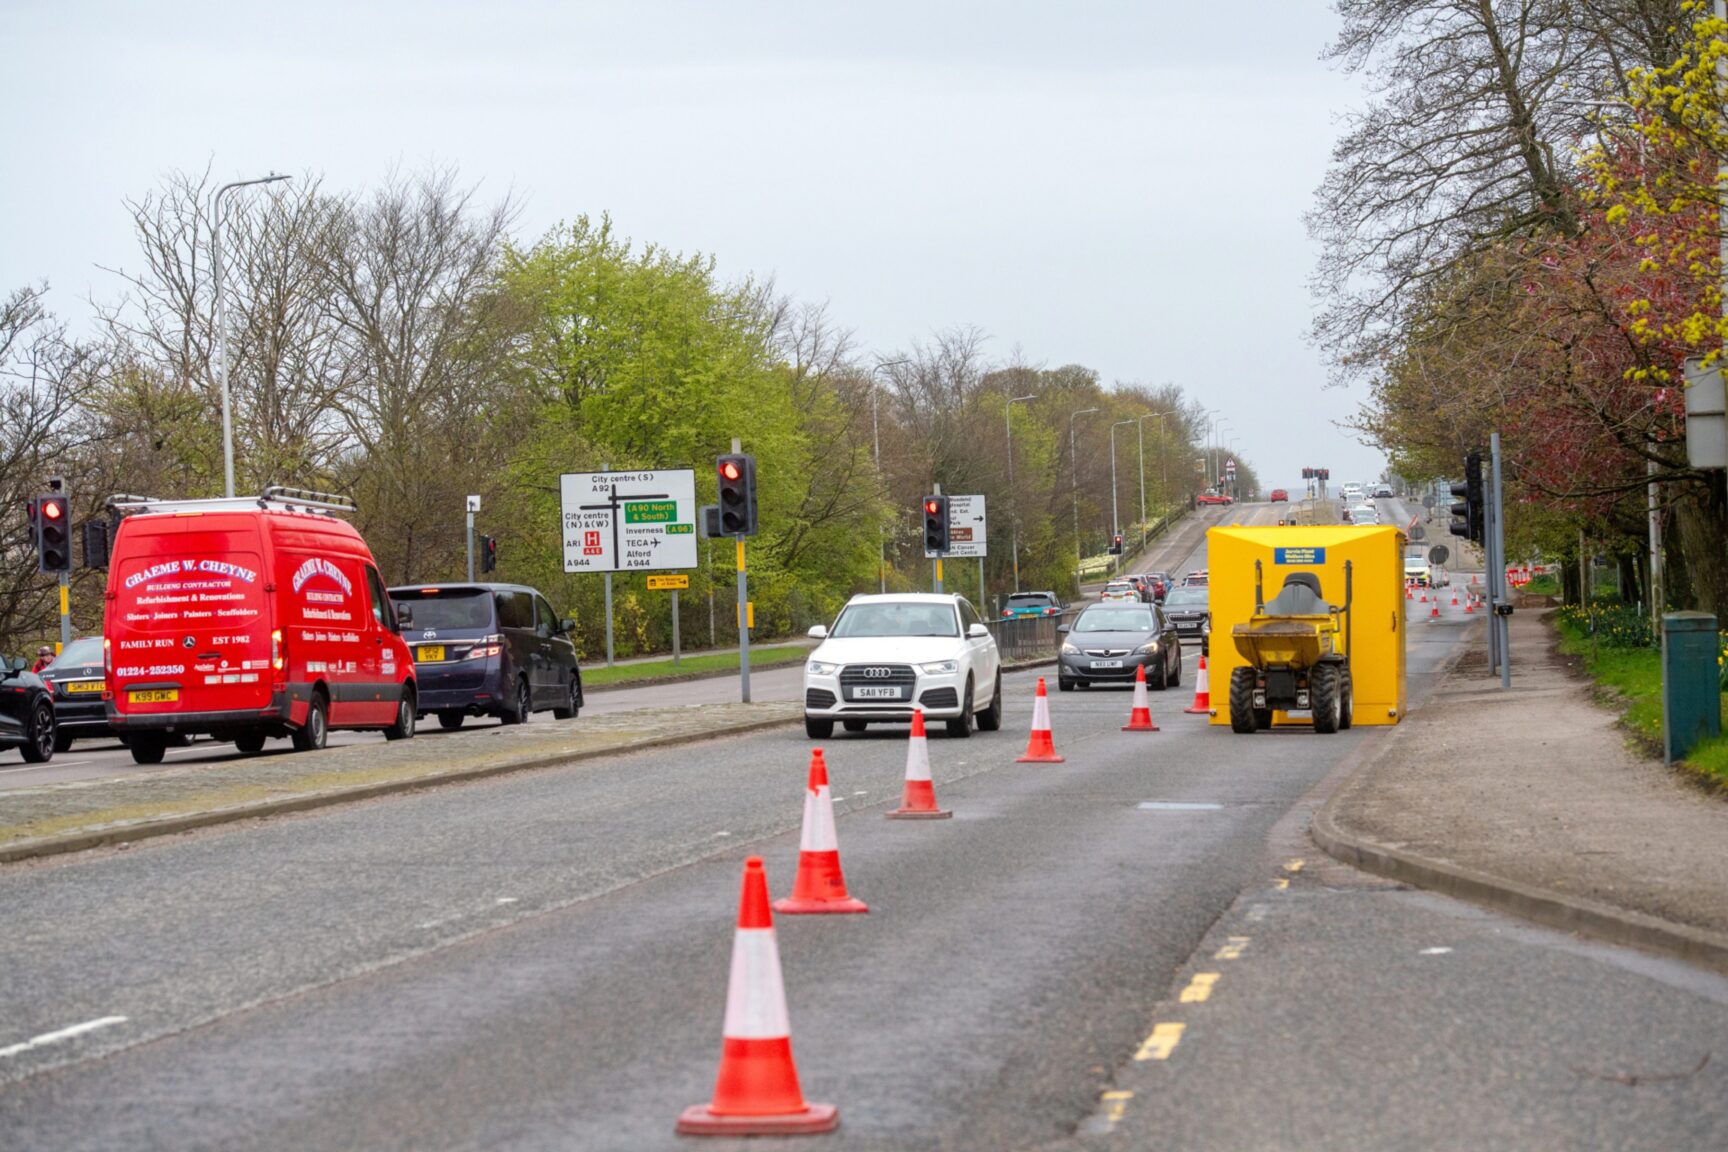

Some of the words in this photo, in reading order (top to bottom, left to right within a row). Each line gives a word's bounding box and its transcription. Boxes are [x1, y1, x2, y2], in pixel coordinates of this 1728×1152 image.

[592, 476, 608, 484] City
[587, 532, 597, 545] H
[125, 561, 180, 588] GRAEME
[182, 560, 197, 571] W.
[199, 560, 256, 582] CHEYNE
[146, 582, 180, 591] BUILDING
[183, 581, 231, 589] CONTRACTOR
[137, 594, 189, 604] Refurbishment
[200, 593, 245, 601] Renovations
[154, 612, 178, 620] Joiners
[120, 640, 153, 649] FAMILY
[155, 639, 174, 647] RUN
[232, 636, 250, 644] 1982
[135, 691, 152, 701] K99
[154, 690, 172, 700] GWC
[860, 689, 876, 697] SA11
[878, 688, 895, 696] YFB
